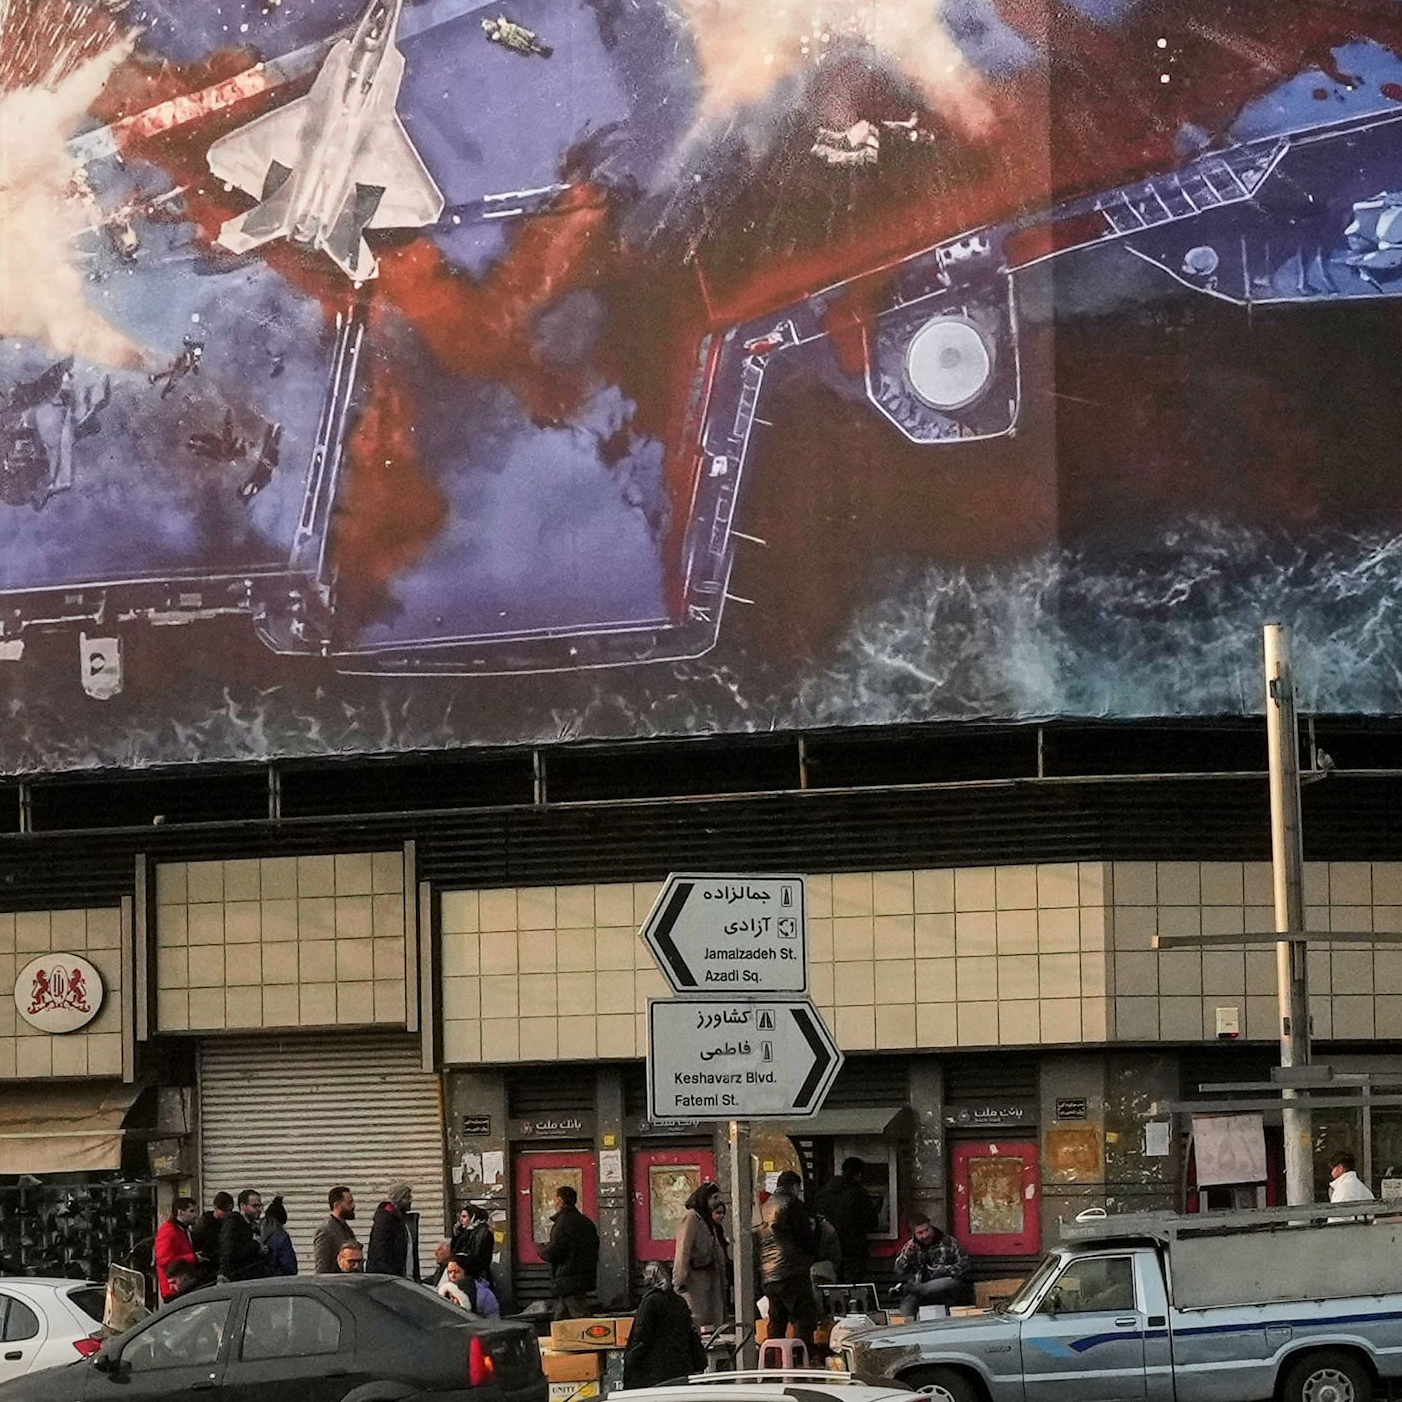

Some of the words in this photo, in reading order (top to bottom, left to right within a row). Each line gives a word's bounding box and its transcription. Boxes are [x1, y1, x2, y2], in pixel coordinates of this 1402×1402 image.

[702, 885, 772, 905] جمالزاده
[724, 916, 772, 938] آزادی
[703, 947, 777, 961] Jamalzadeh
[780, 947, 798, 961] St.
[704, 969, 739, 983] Azadi
[742, 969, 763, 985] Sq.
[695, 1009, 752, 1030] کشاورز
[700, 1042, 752, 1061] فاطمی
[674, 1071, 743, 1085] Keshavarz
[746, 1071, 778, 1085] Blvd.
[674, 1094, 719, 1107] Fatemi
[722, 1094, 740, 1107] St.
